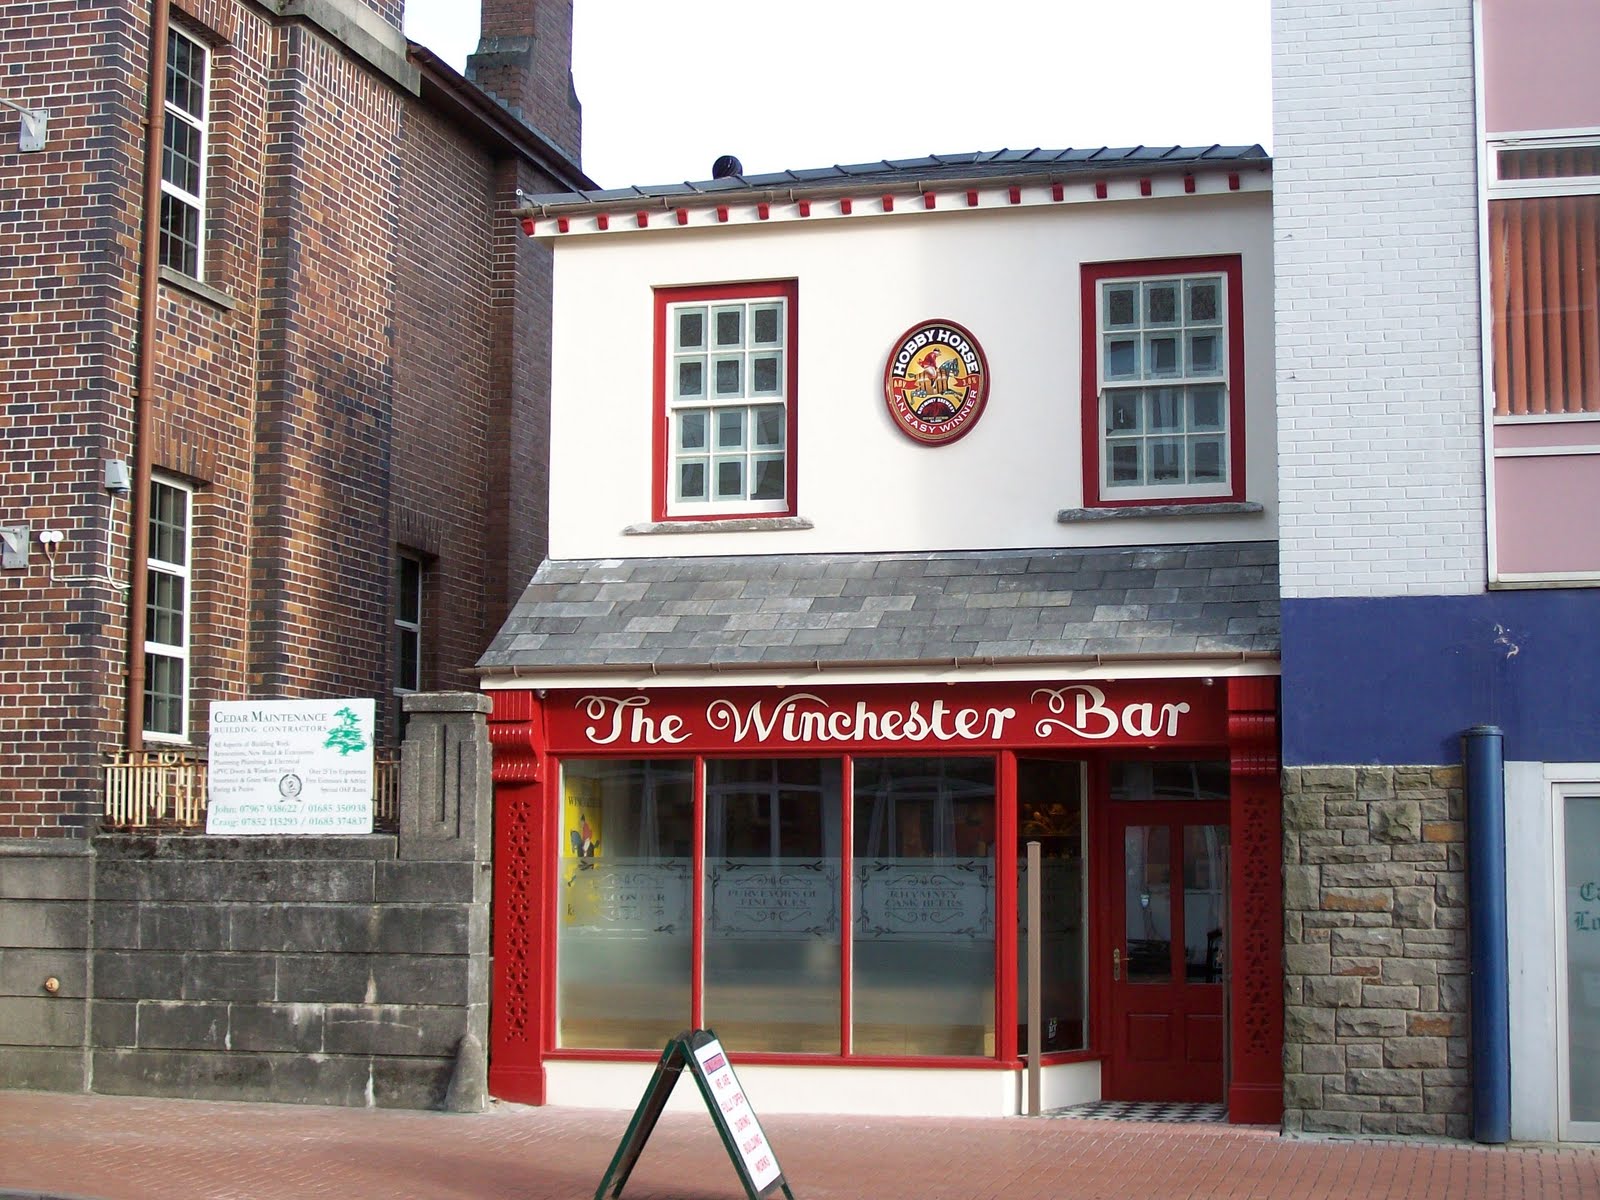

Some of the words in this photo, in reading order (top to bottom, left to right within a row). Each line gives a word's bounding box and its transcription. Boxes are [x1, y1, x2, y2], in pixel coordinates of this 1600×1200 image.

[893, 329, 936, 376] HOBBY
[937, 329, 979, 374] HORSE
[894, 394, 907, 412] AN
[904, 413, 936, 433] EASY
[939, 389, 978, 433] WINNER
[575, 695, 693, 744] The
[706, 693, 1016, 743] Winchester
[1030, 684, 1190, 739] Bar
[213, 726, 257, 734] BUILDING
[262, 725, 327, 733] CONTRACTORS
[212, 818, 239, 827] Craig:
[308, 817, 334, 826] 01685
[214, 805, 237, 815] John:
[239, 805, 265, 813] 07967
[307, 804, 333, 813] 01685
